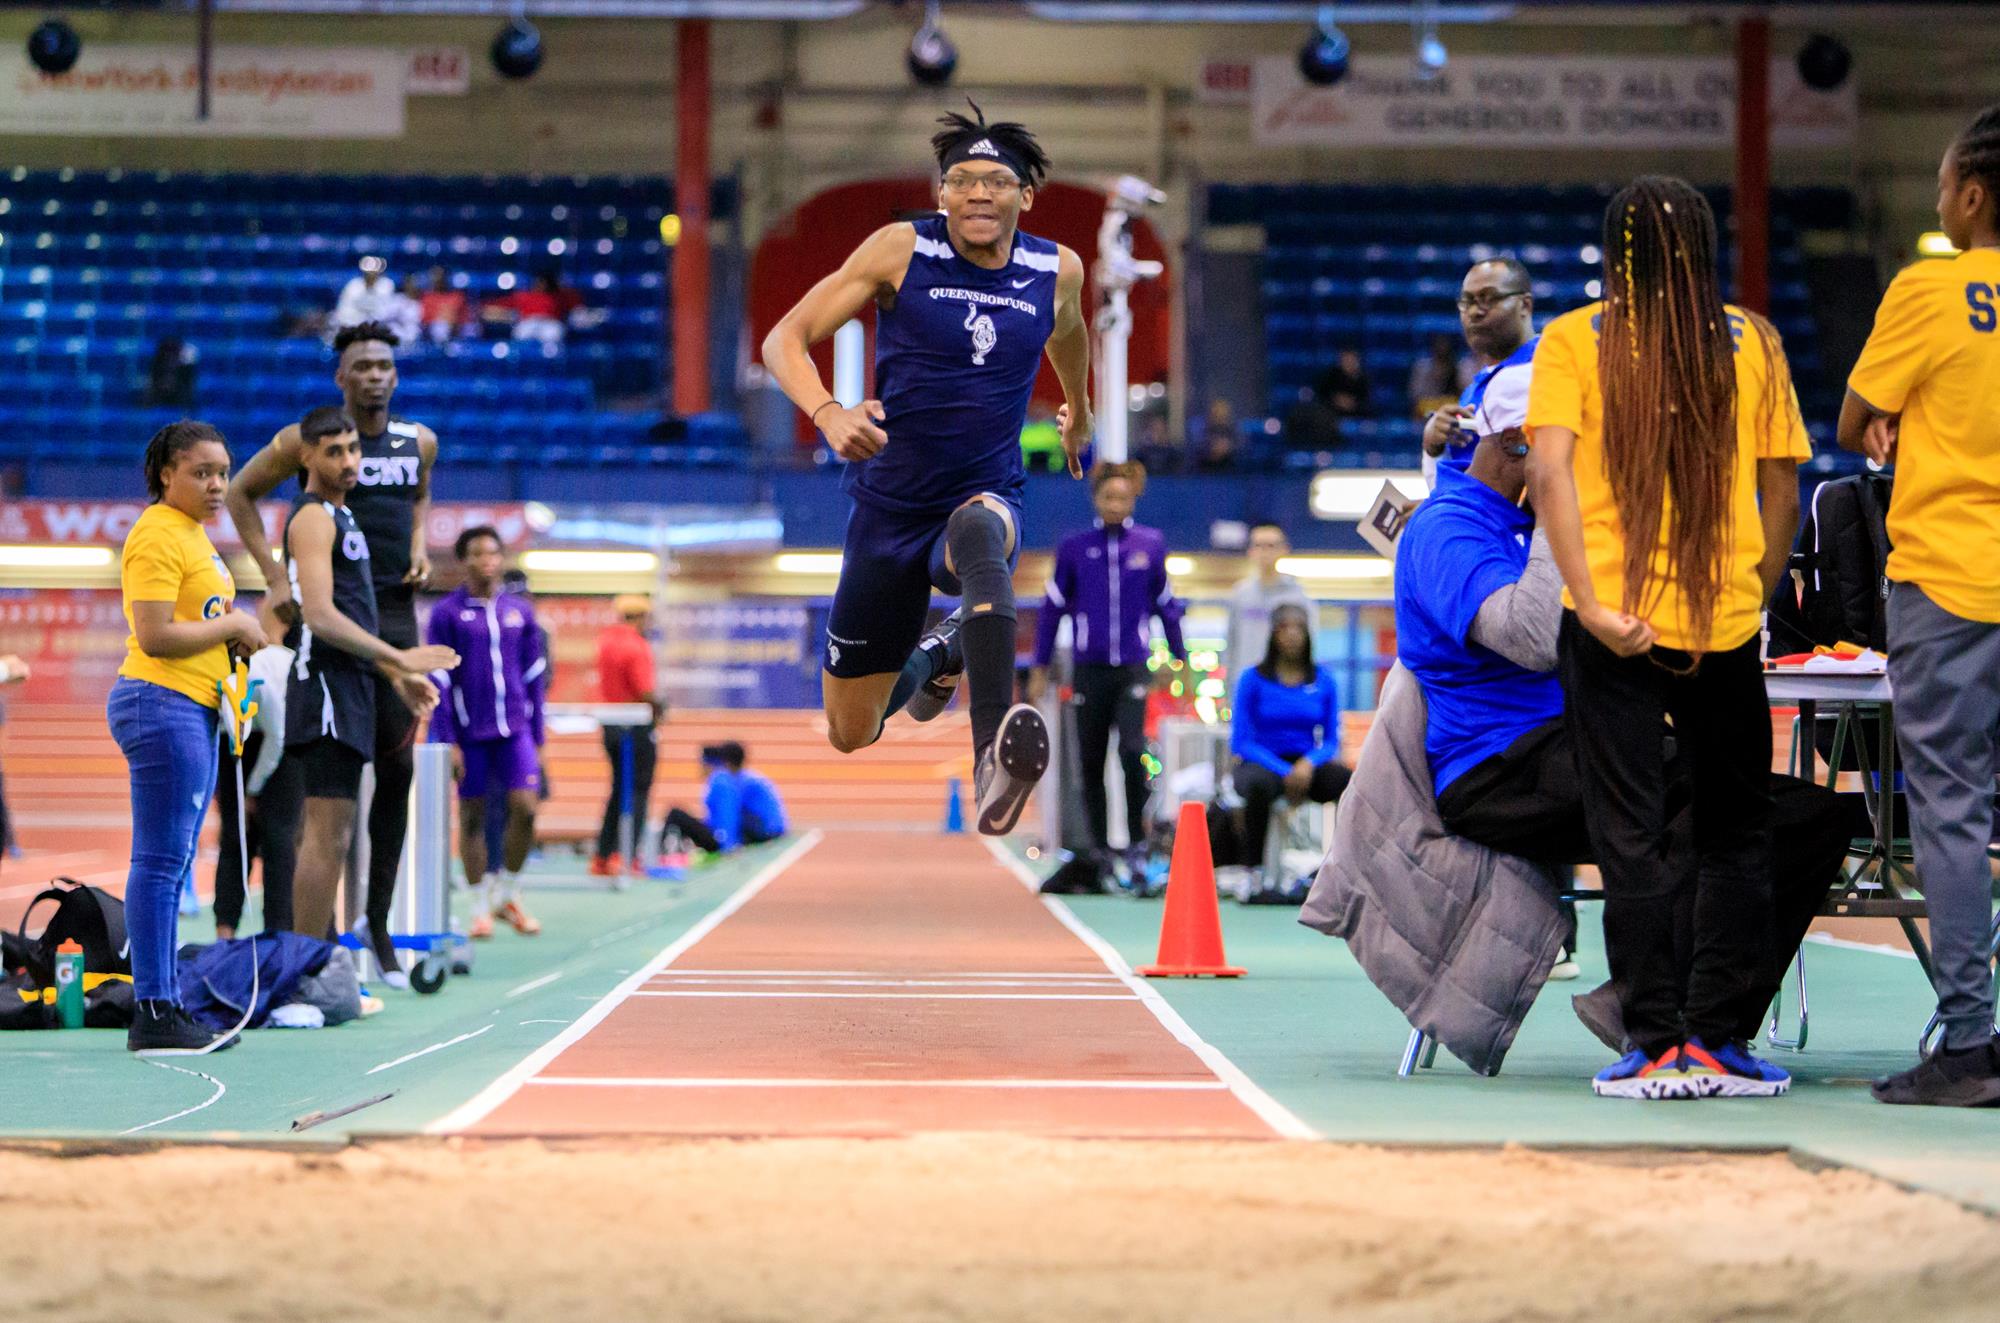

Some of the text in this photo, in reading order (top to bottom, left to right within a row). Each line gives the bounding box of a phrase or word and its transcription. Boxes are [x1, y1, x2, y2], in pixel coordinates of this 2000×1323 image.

[1475, 72, 1544, 98] YOU
[1561, 72, 1604, 98] TO
[1619, 73, 1676, 98] ALL
[968, 147, 999, 157] adidas
[929, 287, 1037, 317] QUEENSBOROUGH
[1965, 282, 2000, 333] S
